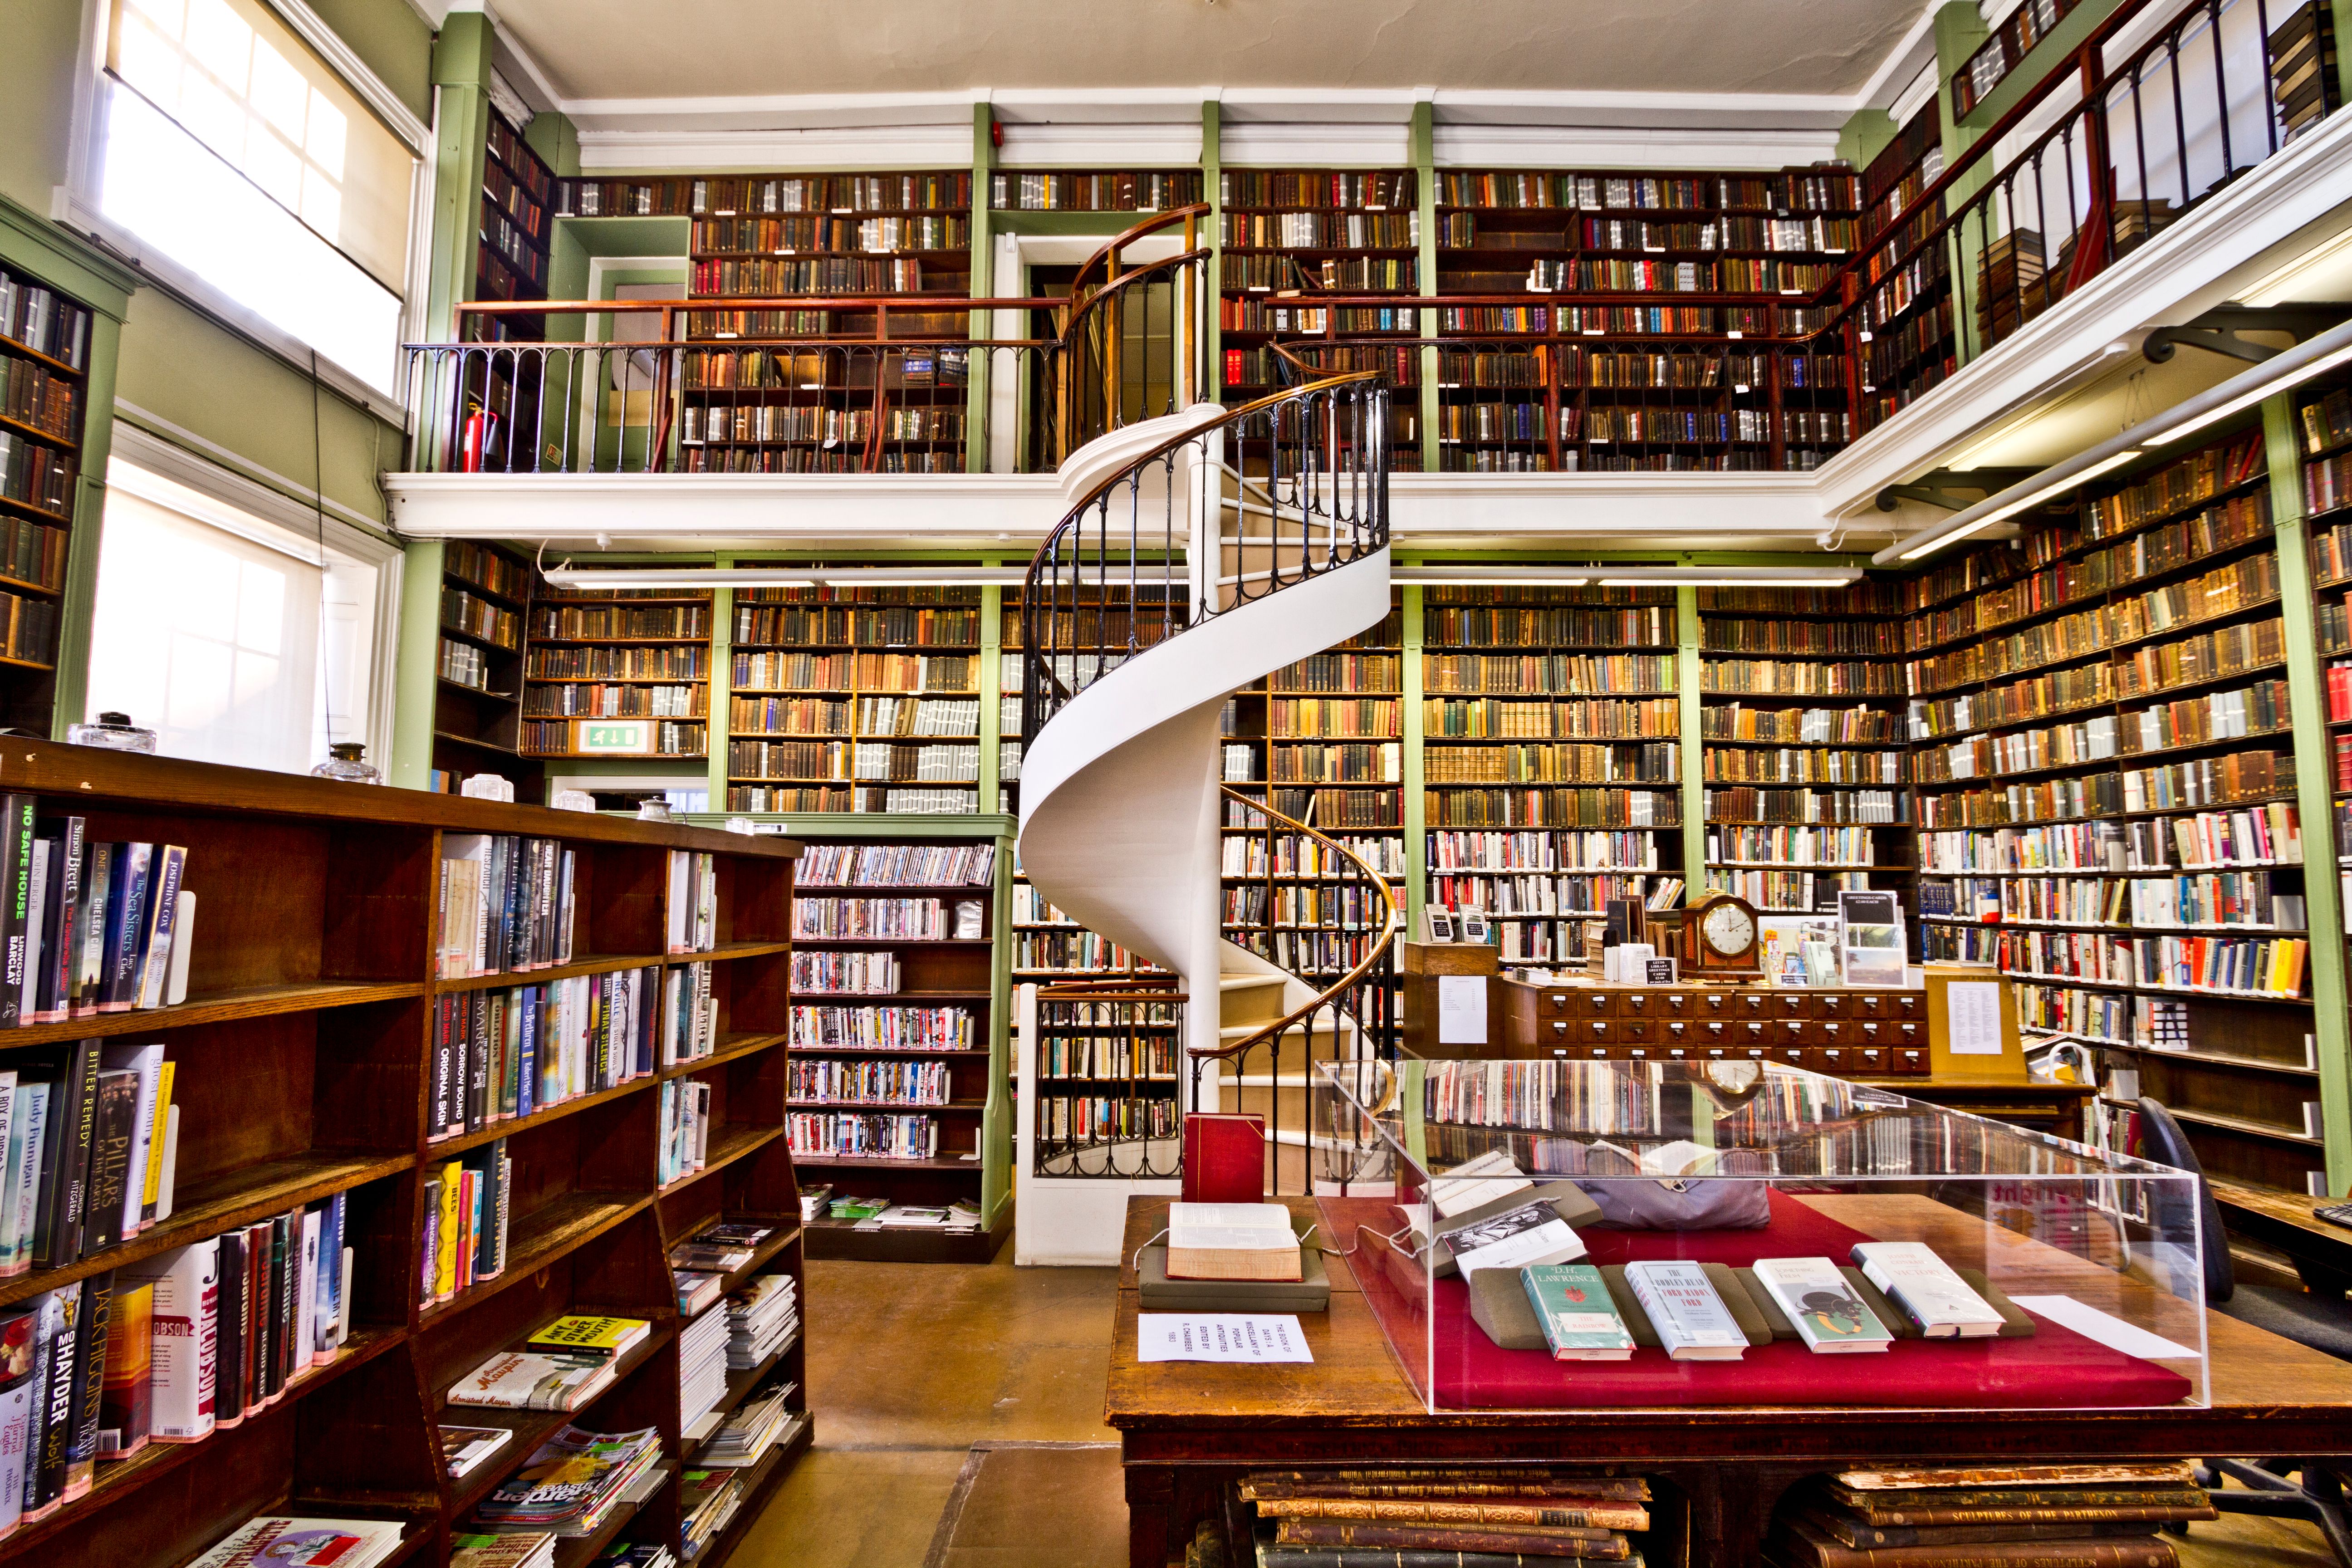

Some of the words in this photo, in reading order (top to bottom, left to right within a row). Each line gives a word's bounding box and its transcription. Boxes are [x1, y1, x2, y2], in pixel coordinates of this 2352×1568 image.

[23, 806, 33, 826] NO
[20, 830, 31, 867] SAFE
[72, 824, 83, 855] Simon
[33, 855, 42, 877] JOHN
[98, 850, 106, 869] ONE
[483, 848, 492, 889] RESEARCH
[544, 845, 553, 867] DEAR
[68, 857, 81, 891] Brett
[137, 878, 145, 891] The
[164, 861, 178, 907] JOSEPHINE
[510, 851, 519, 907] STEPHEN
[16, 871, 28, 919] HOUSE
[30, 879, 39, 910] BERGER
[128, 892, 142, 911] Sea
[542, 870, 552, 916] DAUGHTER
[91, 898, 103, 935] CHELSEA
[161, 910, 170, 927] COX
[480, 910, 489, 934] PHILIP
[62, 923, 72, 965] Cinderella
[90, 938, 99, 957] CAIN
[123, 914, 139, 951] Sisters
[6, 936, 18, 985] BARCLAY
[16, 936, 24, 985] LINWOOD
[119, 958, 127, 980] Clarke
[127, 954, 136, 970] Lucy
[148, 952, 158, 978] Woman
[154, 953, 167, 985] Runaway
[60, 968, 69, 991] Killer
[524, 1014, 534, 1047] Brethren
[699, 1010, 708, 1039] ACRES
[458, 1044, 466, 1084] SORROW
[600, 1034, 608, 1073] SILENCE
[85, 1051, 98, 1092] BITTER
[150, 1058, 162, 1093] ghost
[439, 1048, 449, 1099] ORIGINAL
[0, 1096, 10, 1114] BOX
[29, 1094, 44, 1123] Judy
[145, 1100, 156, 1132] moth
[438, 1101, 447, 1126] SKIN
[456, 1087, 464, 1119] BOUND
[79, 1098, 93, 1148] REMEDY
[24, 1127, 40, 1189] Finnigan
[97, 1140, 104, 1152] OF
[94, 1156, 103, 1176] THE
[68, 1180, 79, 1222] FITZGERALD
[92, 1179, 101, 1211] EARTH
[427, 1215, 436, 1265] HANGMAN'S
[93, 1288, 111, 1338] JACK
[332, 1278, 340, 1319] ENEMY
[58, 1331, 75, 1346] MO
[544, 1325, 573, 1339] ANY
[562, 1321, 598, 1342] OTHER
[577, 1318, 620, 1343] MOUTH
[1183, 1328, 1193, 1352] CHAMBERS
[1200, 1326, 1209, 1342] EDITED
[1216, 1324, 1228, 1352] ANTIQUITIES
[1232, 1328, 1243, 1348] POPULAR
[1245, 1321, 1259, 1348] MISCELLANY
[1262, 1329, 1272, 1340] DAYS
[1275, 1324, 1284, 1332] THE
[1279, 1333, 1289, 1346] BOOK
[199, 1308, 217, 1404] JACOBSON
[50, 1347, 74, 1425] HAYDER
[84, 1338, 105, 1416] HIGGINS
[477, 1358, 525, 1390] Maupin
[451, 1394, 483, 1403] Armistead
[486, 1396, 511, 1406] Maupin
[2, 1425, 13, 1455] Eagles
[45, 1428, 64, 1468] Wolf
[77, 1422, 89, 1460] TRADE
[4, 1468, 14, 1504] PHOENIX
